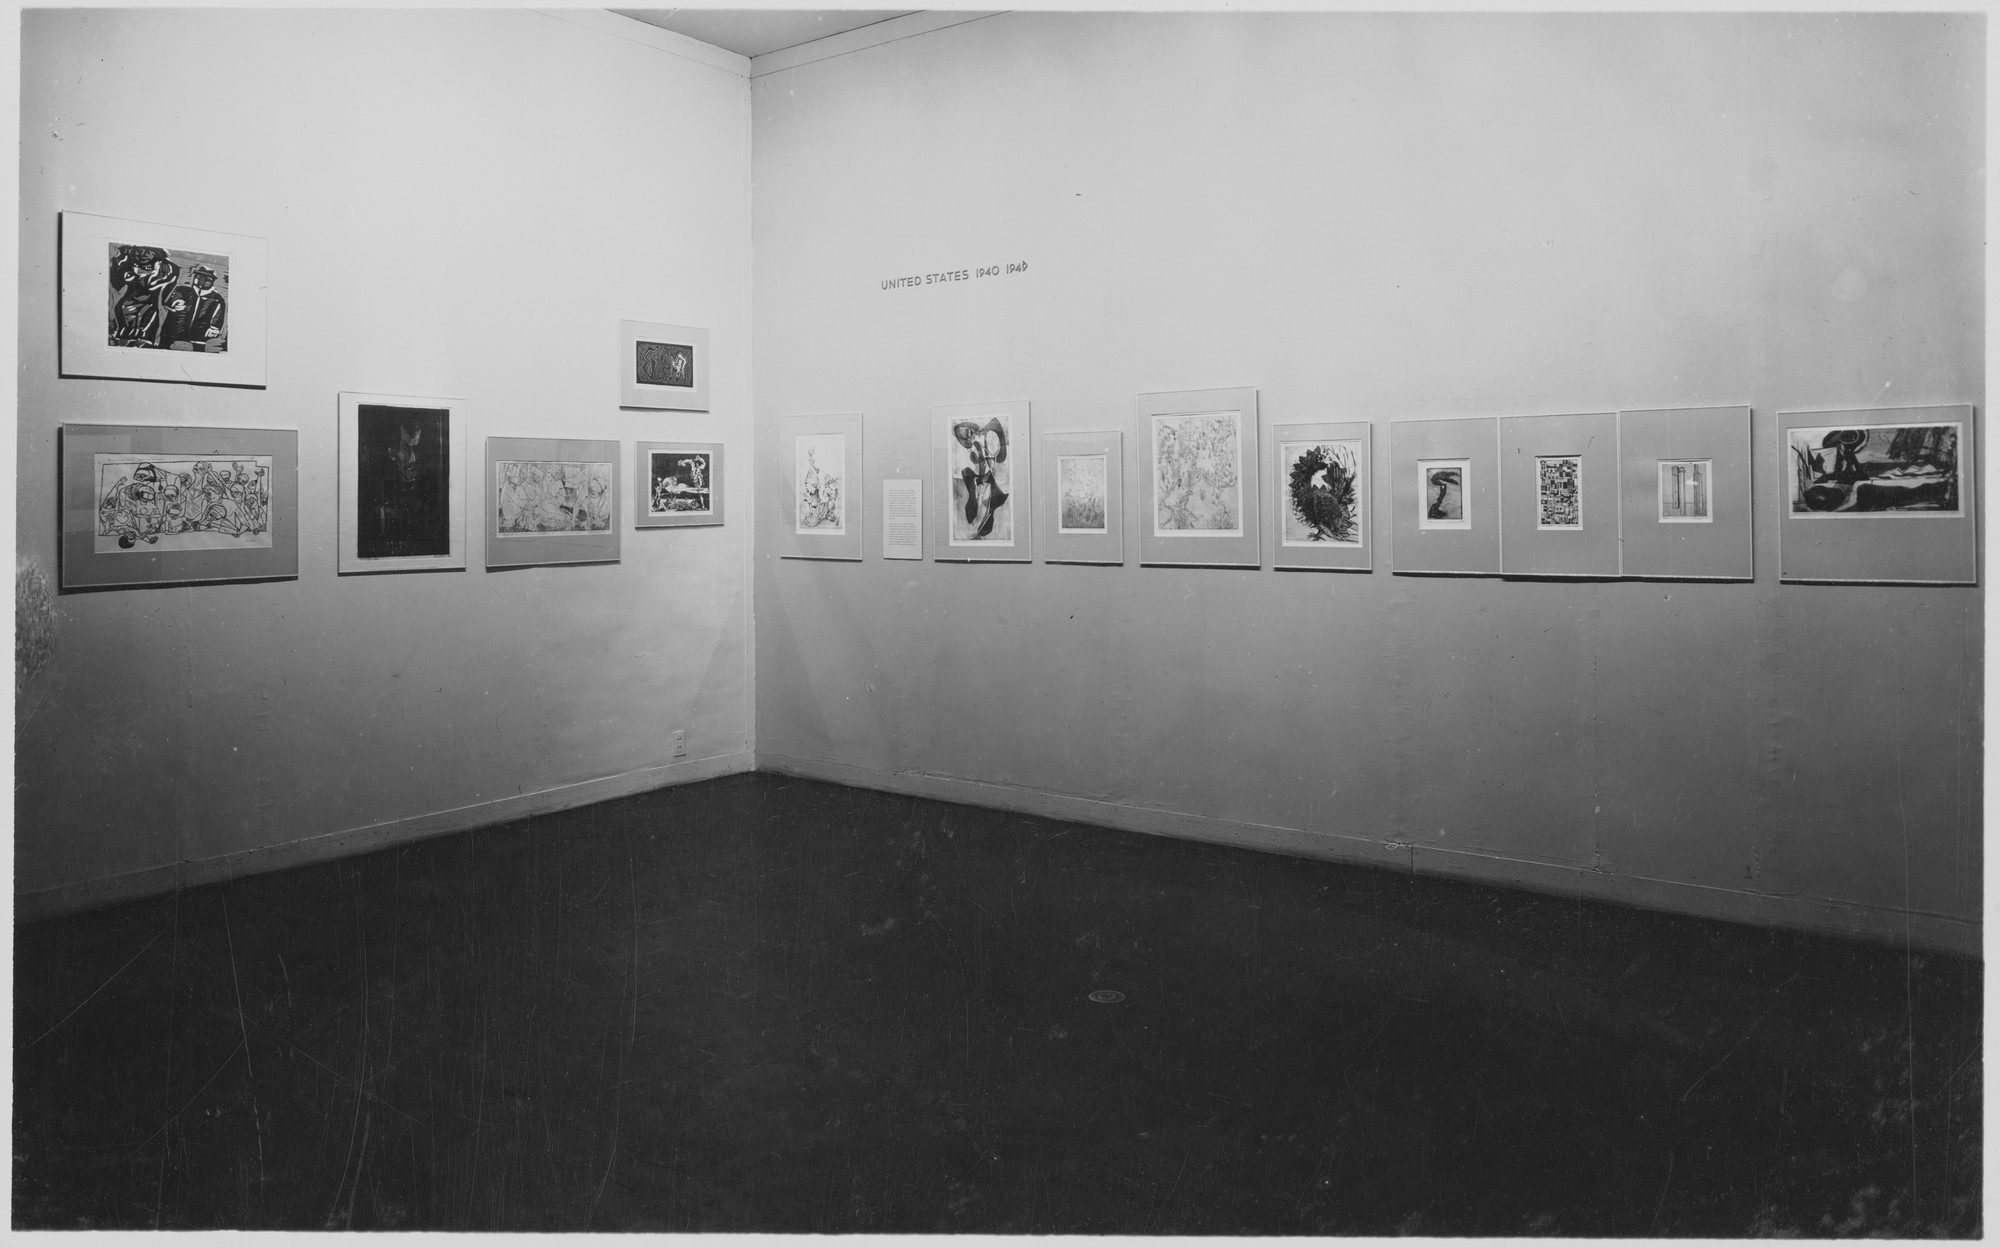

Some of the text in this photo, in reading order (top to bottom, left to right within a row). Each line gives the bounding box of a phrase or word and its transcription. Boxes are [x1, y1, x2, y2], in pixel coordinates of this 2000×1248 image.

[881, 276, 921, 290] UNITED
[926, 270, 969, 285] STATES
[976, 265, 1000, 278] 1940
